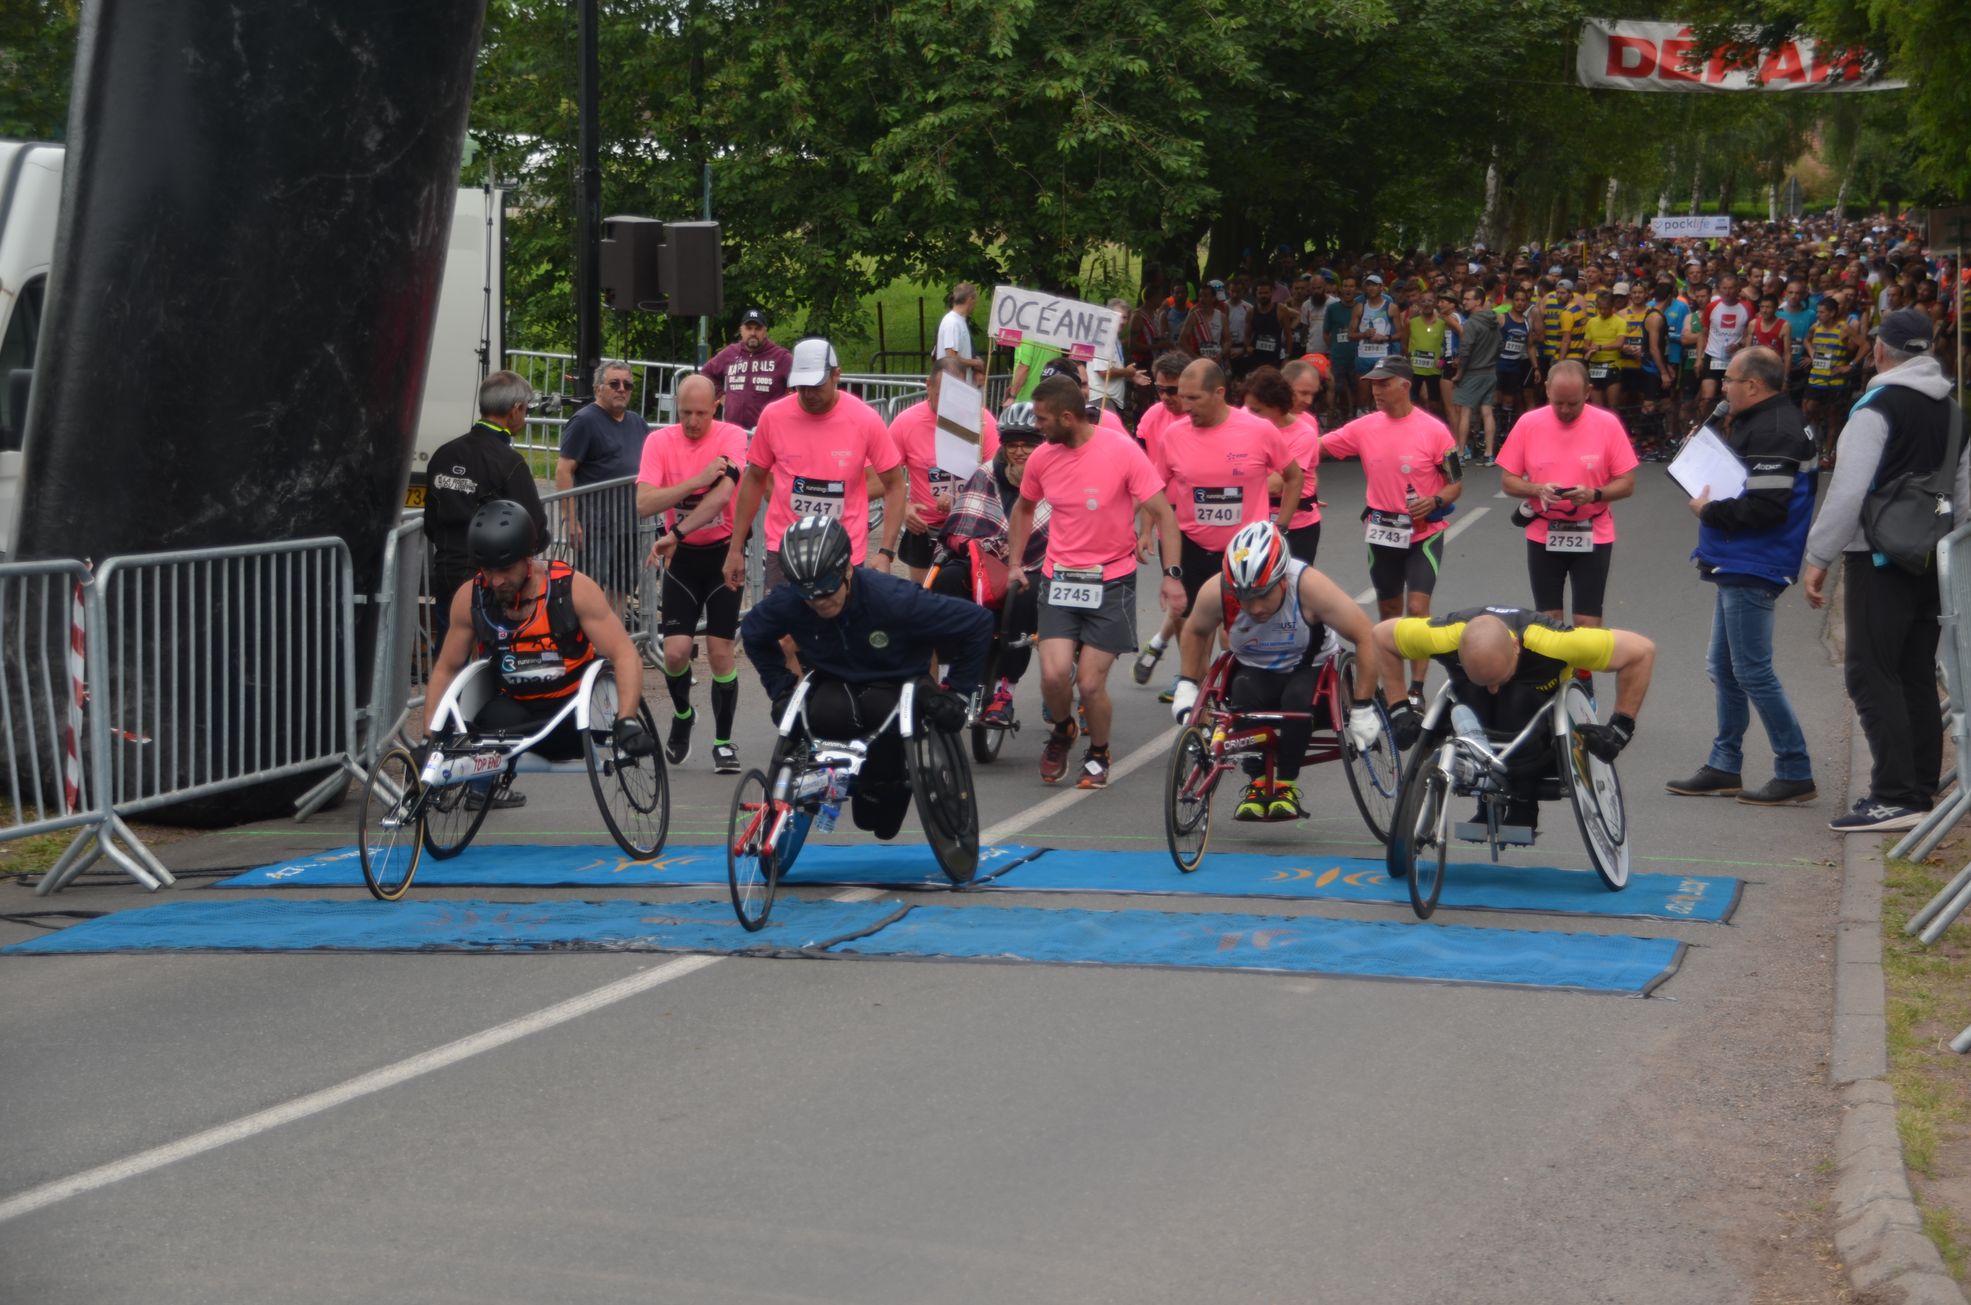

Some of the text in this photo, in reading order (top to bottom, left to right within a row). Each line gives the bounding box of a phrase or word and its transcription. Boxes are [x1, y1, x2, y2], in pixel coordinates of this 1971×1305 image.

[998, 295, 1113, 347] OCÉANE
[405, 487, 426, 505] 73
[794, 499, 832, 515] 2747
[1197, 508, 1233, 521] 2740
[1369, 528, 1401, 543] 2743
[1549, 535, 1583, 548] 2752
[1053, 587, 1090, 602] 2745
[473, 752, 502, 773] TOP END
